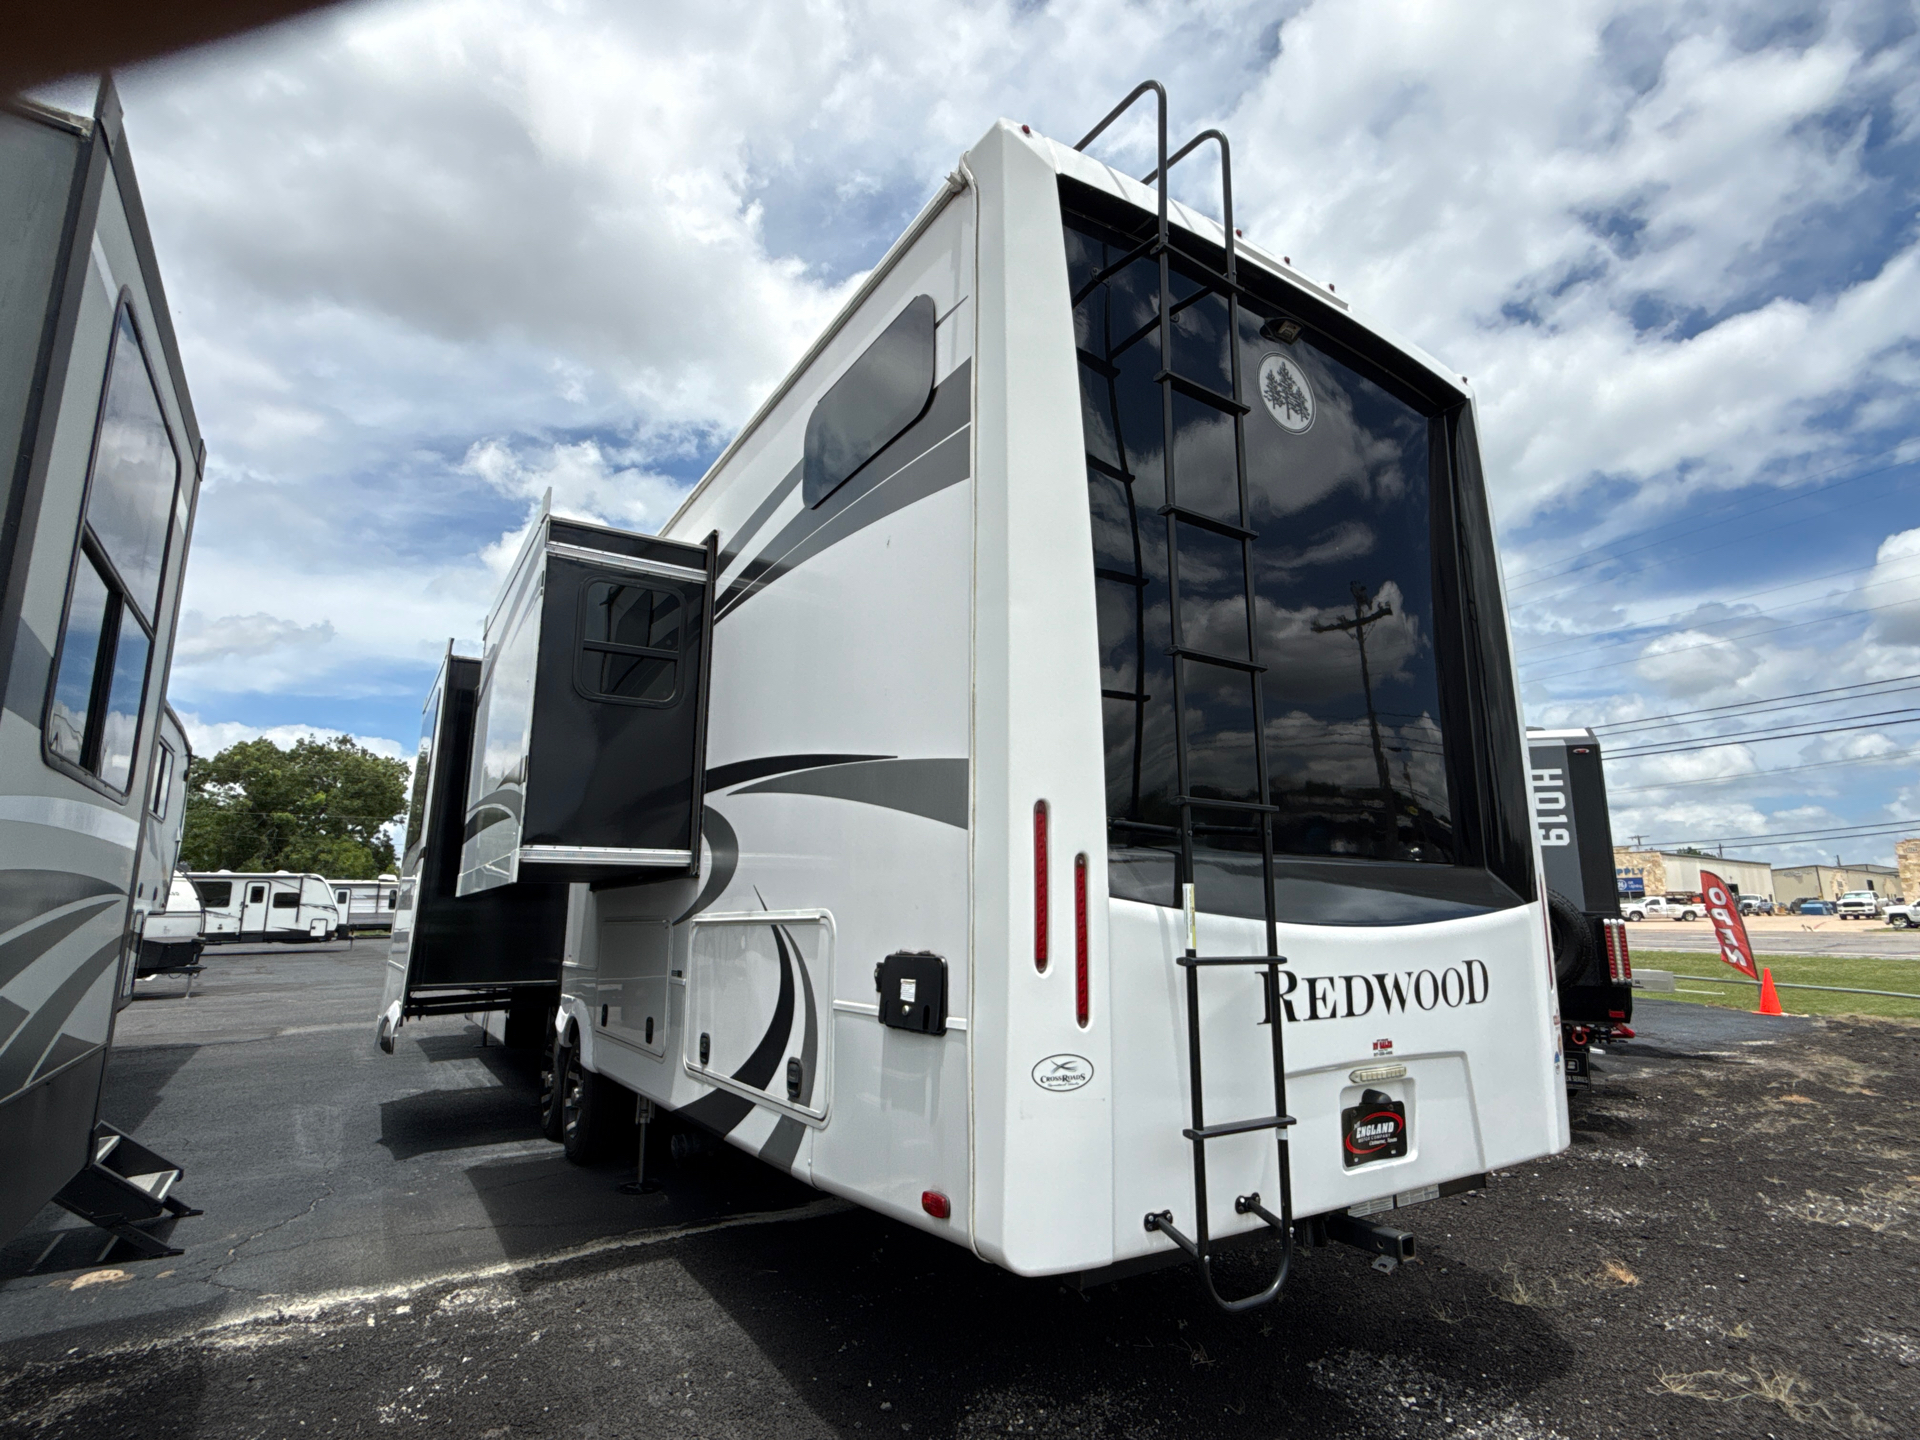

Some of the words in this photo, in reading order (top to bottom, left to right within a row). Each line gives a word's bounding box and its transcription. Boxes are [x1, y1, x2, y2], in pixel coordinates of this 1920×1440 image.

[1615, 867, 1644, 876] PPLY
[1255, 959, 1490, 1025] REDWOOD
[1356, 1121, 1394, 1139] ENGLAND
